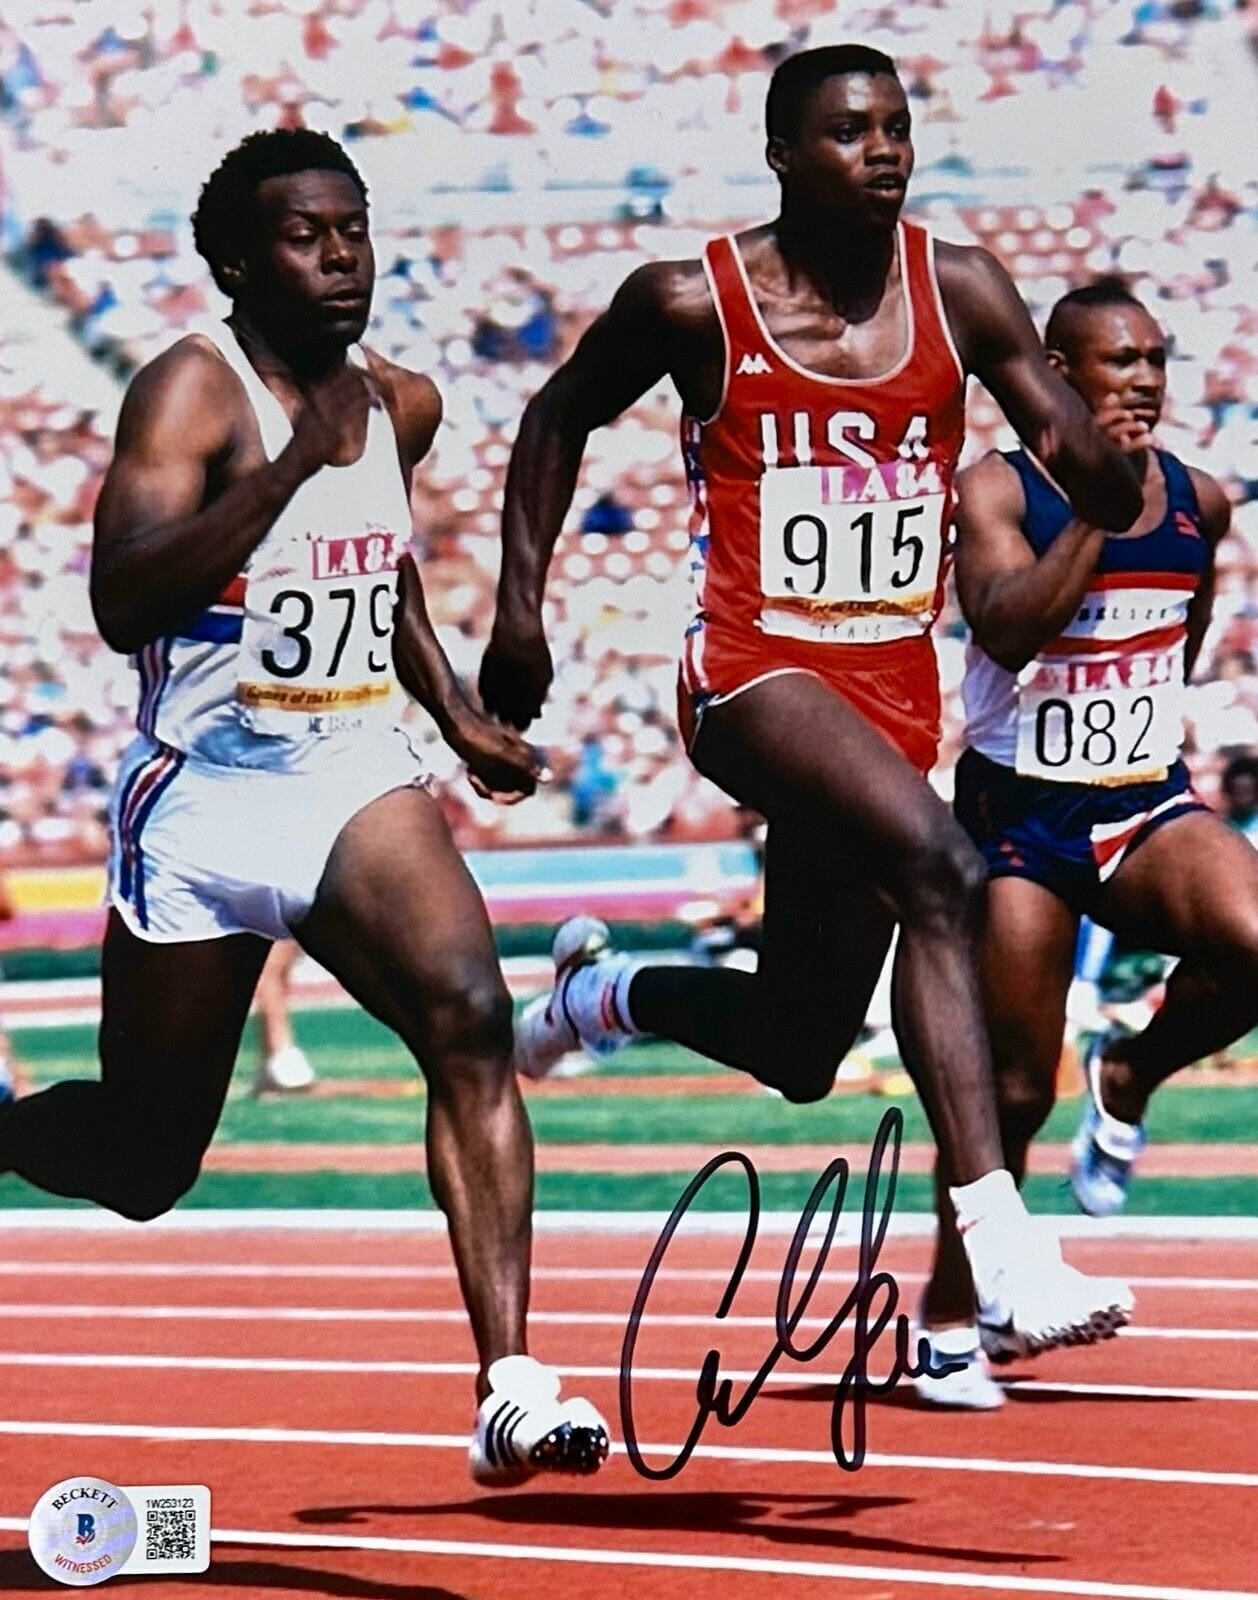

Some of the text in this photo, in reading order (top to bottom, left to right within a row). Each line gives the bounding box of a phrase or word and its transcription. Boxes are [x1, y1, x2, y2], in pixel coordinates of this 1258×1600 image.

[760, 411, 927, 469] USA
[783, 505, 925, 594] 915
[261, 583, 391, 678] 379
[1036, 695, 1154, 767] 082
[51, 1487, 119, 1511] BECKETT
[145, 1498, 194, 1509] 1W253123
[54, 1553, 113, 1574] WITNESSED
